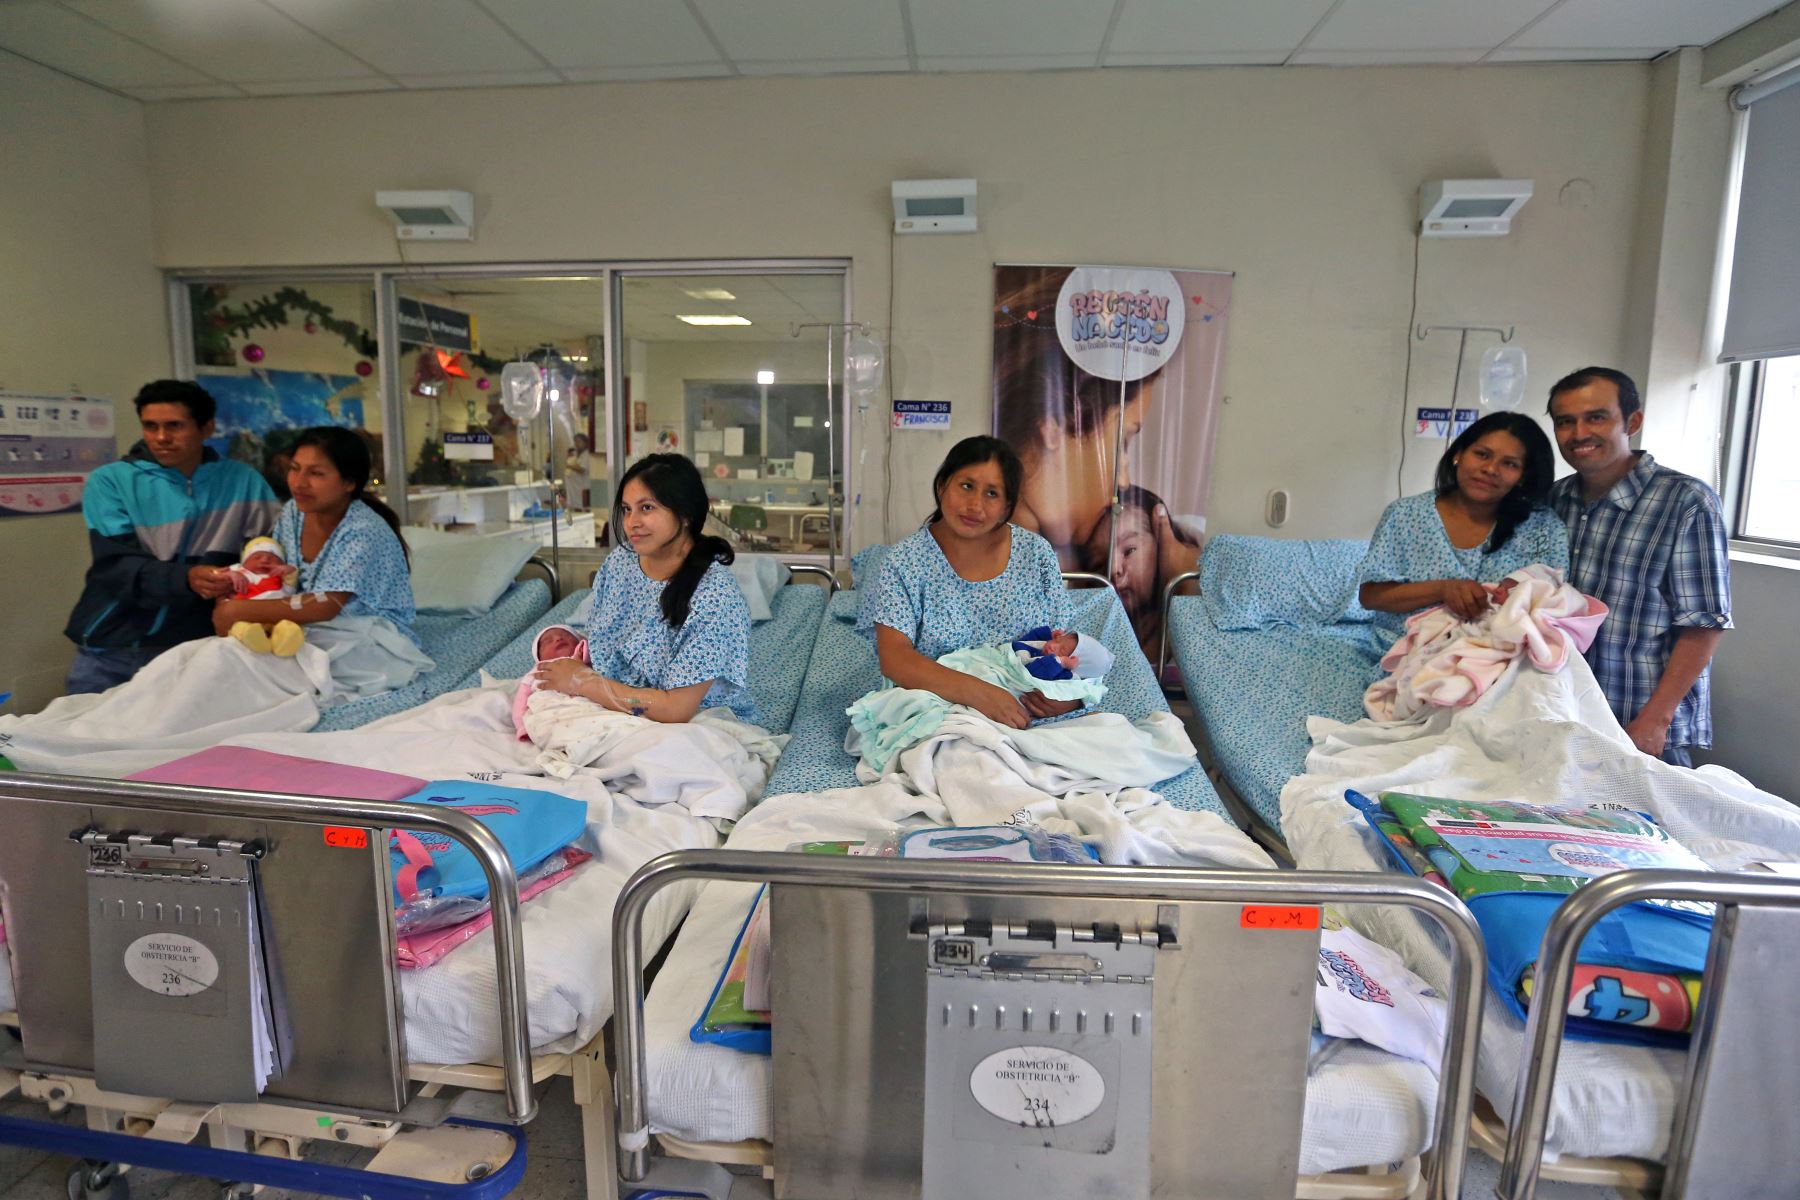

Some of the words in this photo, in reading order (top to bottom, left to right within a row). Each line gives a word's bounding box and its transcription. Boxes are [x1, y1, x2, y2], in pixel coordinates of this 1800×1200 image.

[1069, 289, 1170, 321] RECIÉN
[1072, 312, 1170, 345] NACIDO
[897, 402, 919, 411] Cama
[921, 403, 931, 412] N°
[933, 403, 948, 412] 236
[1422, 410, 1445, 419] Cama
[446, 434, 466, 442] Cama
[326, 831, 336, 845] C
[1246, 910, 1256, 924] C
[1284, 912, 1303, 926] M
[148, 943, 182, 953] SERVICIO
[938, 942, 970, 960] 234
[141, 952, 187, 962] OBSTETRICIA
[162, 973, 181, 985] 236
[1007, 1060, 1053, 1071] SERVICIO
[1056, 1062, 1070, 1072] DE
[995, 1071, 1061, 1083] OBSTETRICIA
[1023, 1098, 1049, 1111] 234
